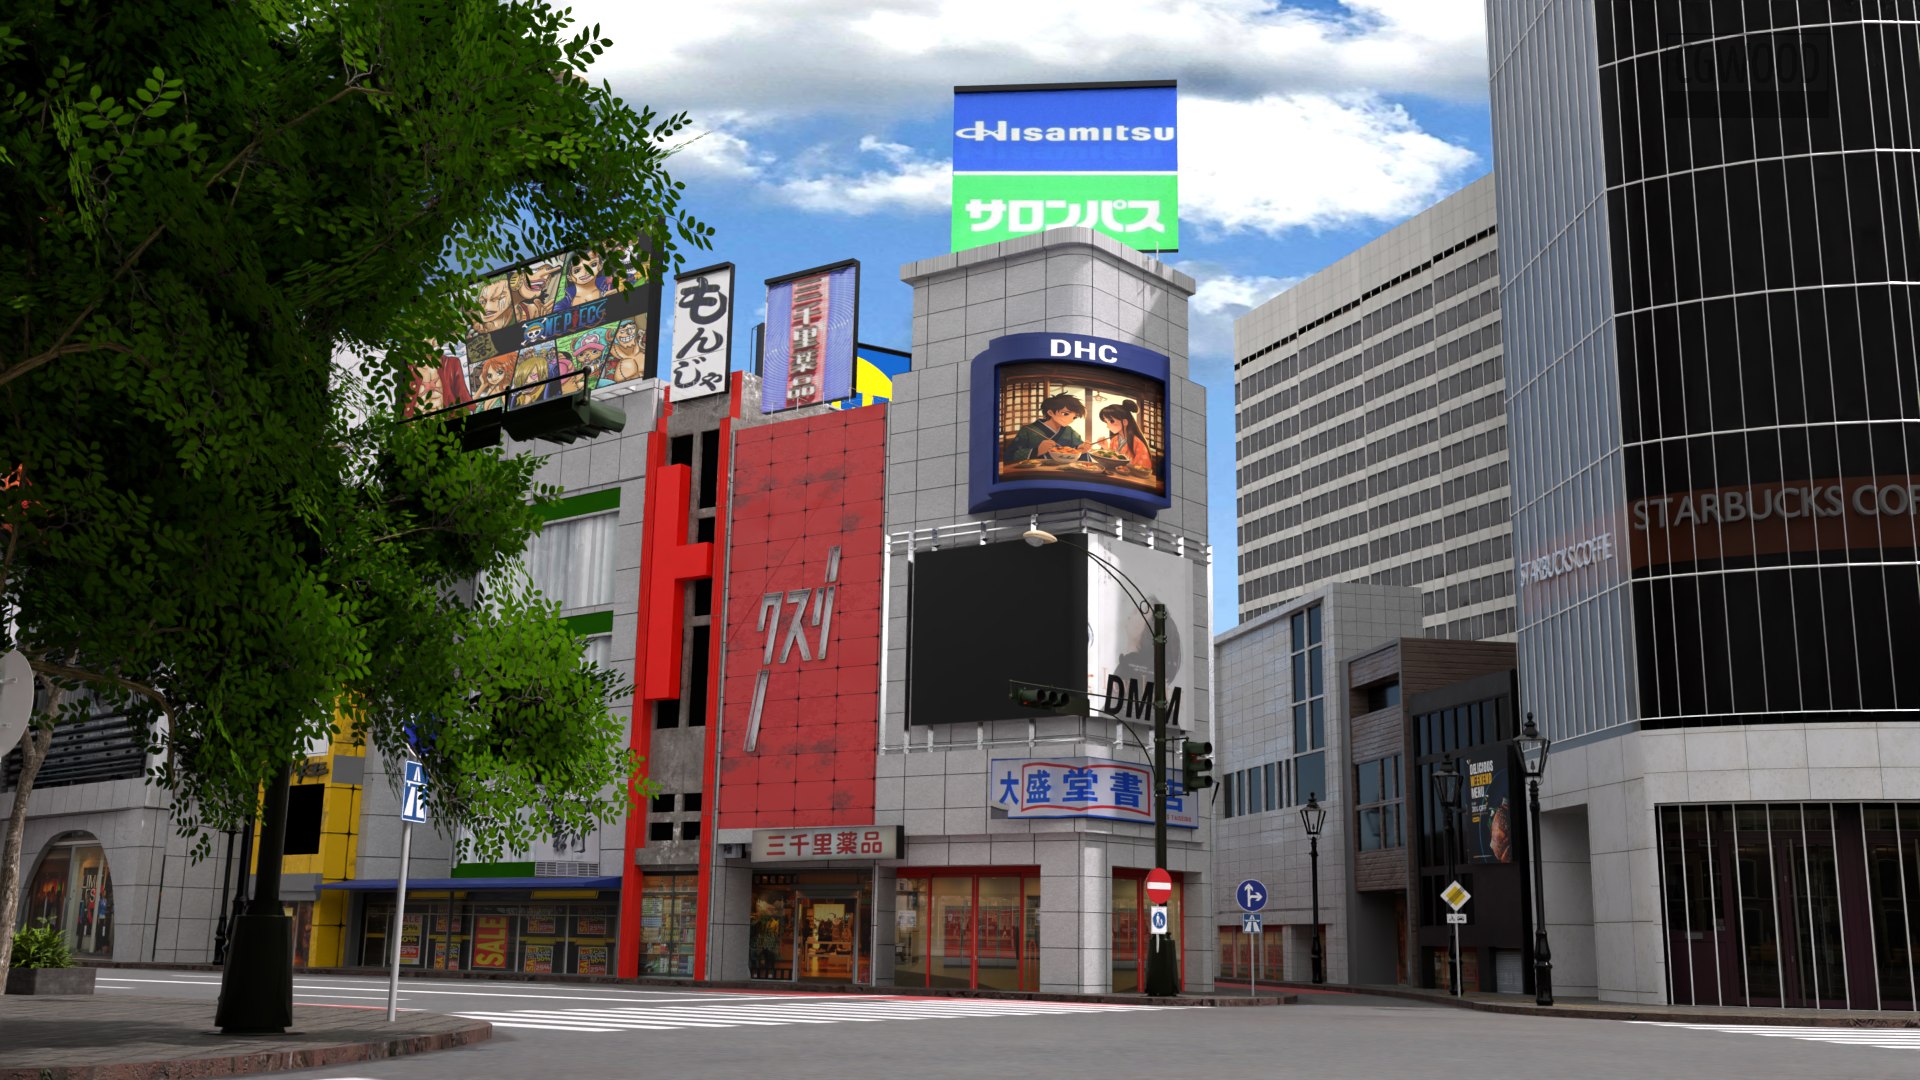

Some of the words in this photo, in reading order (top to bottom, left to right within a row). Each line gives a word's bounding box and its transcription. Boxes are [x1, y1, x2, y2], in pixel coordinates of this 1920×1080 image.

[955, 120, 1175, 142] Hisamitsu
[966, 199, 1165, 233] サロンパス
[673, 276, 728, 392] もんじゃ
[1050, 338, 1118, 364] DHC
[1633, 485, 1844, 532] STARBUCKS
[766, 831, 883, 857] 三千里薬品
[404, 915, 420, 923] ALE
[476, 916, 507, 967] SALE
